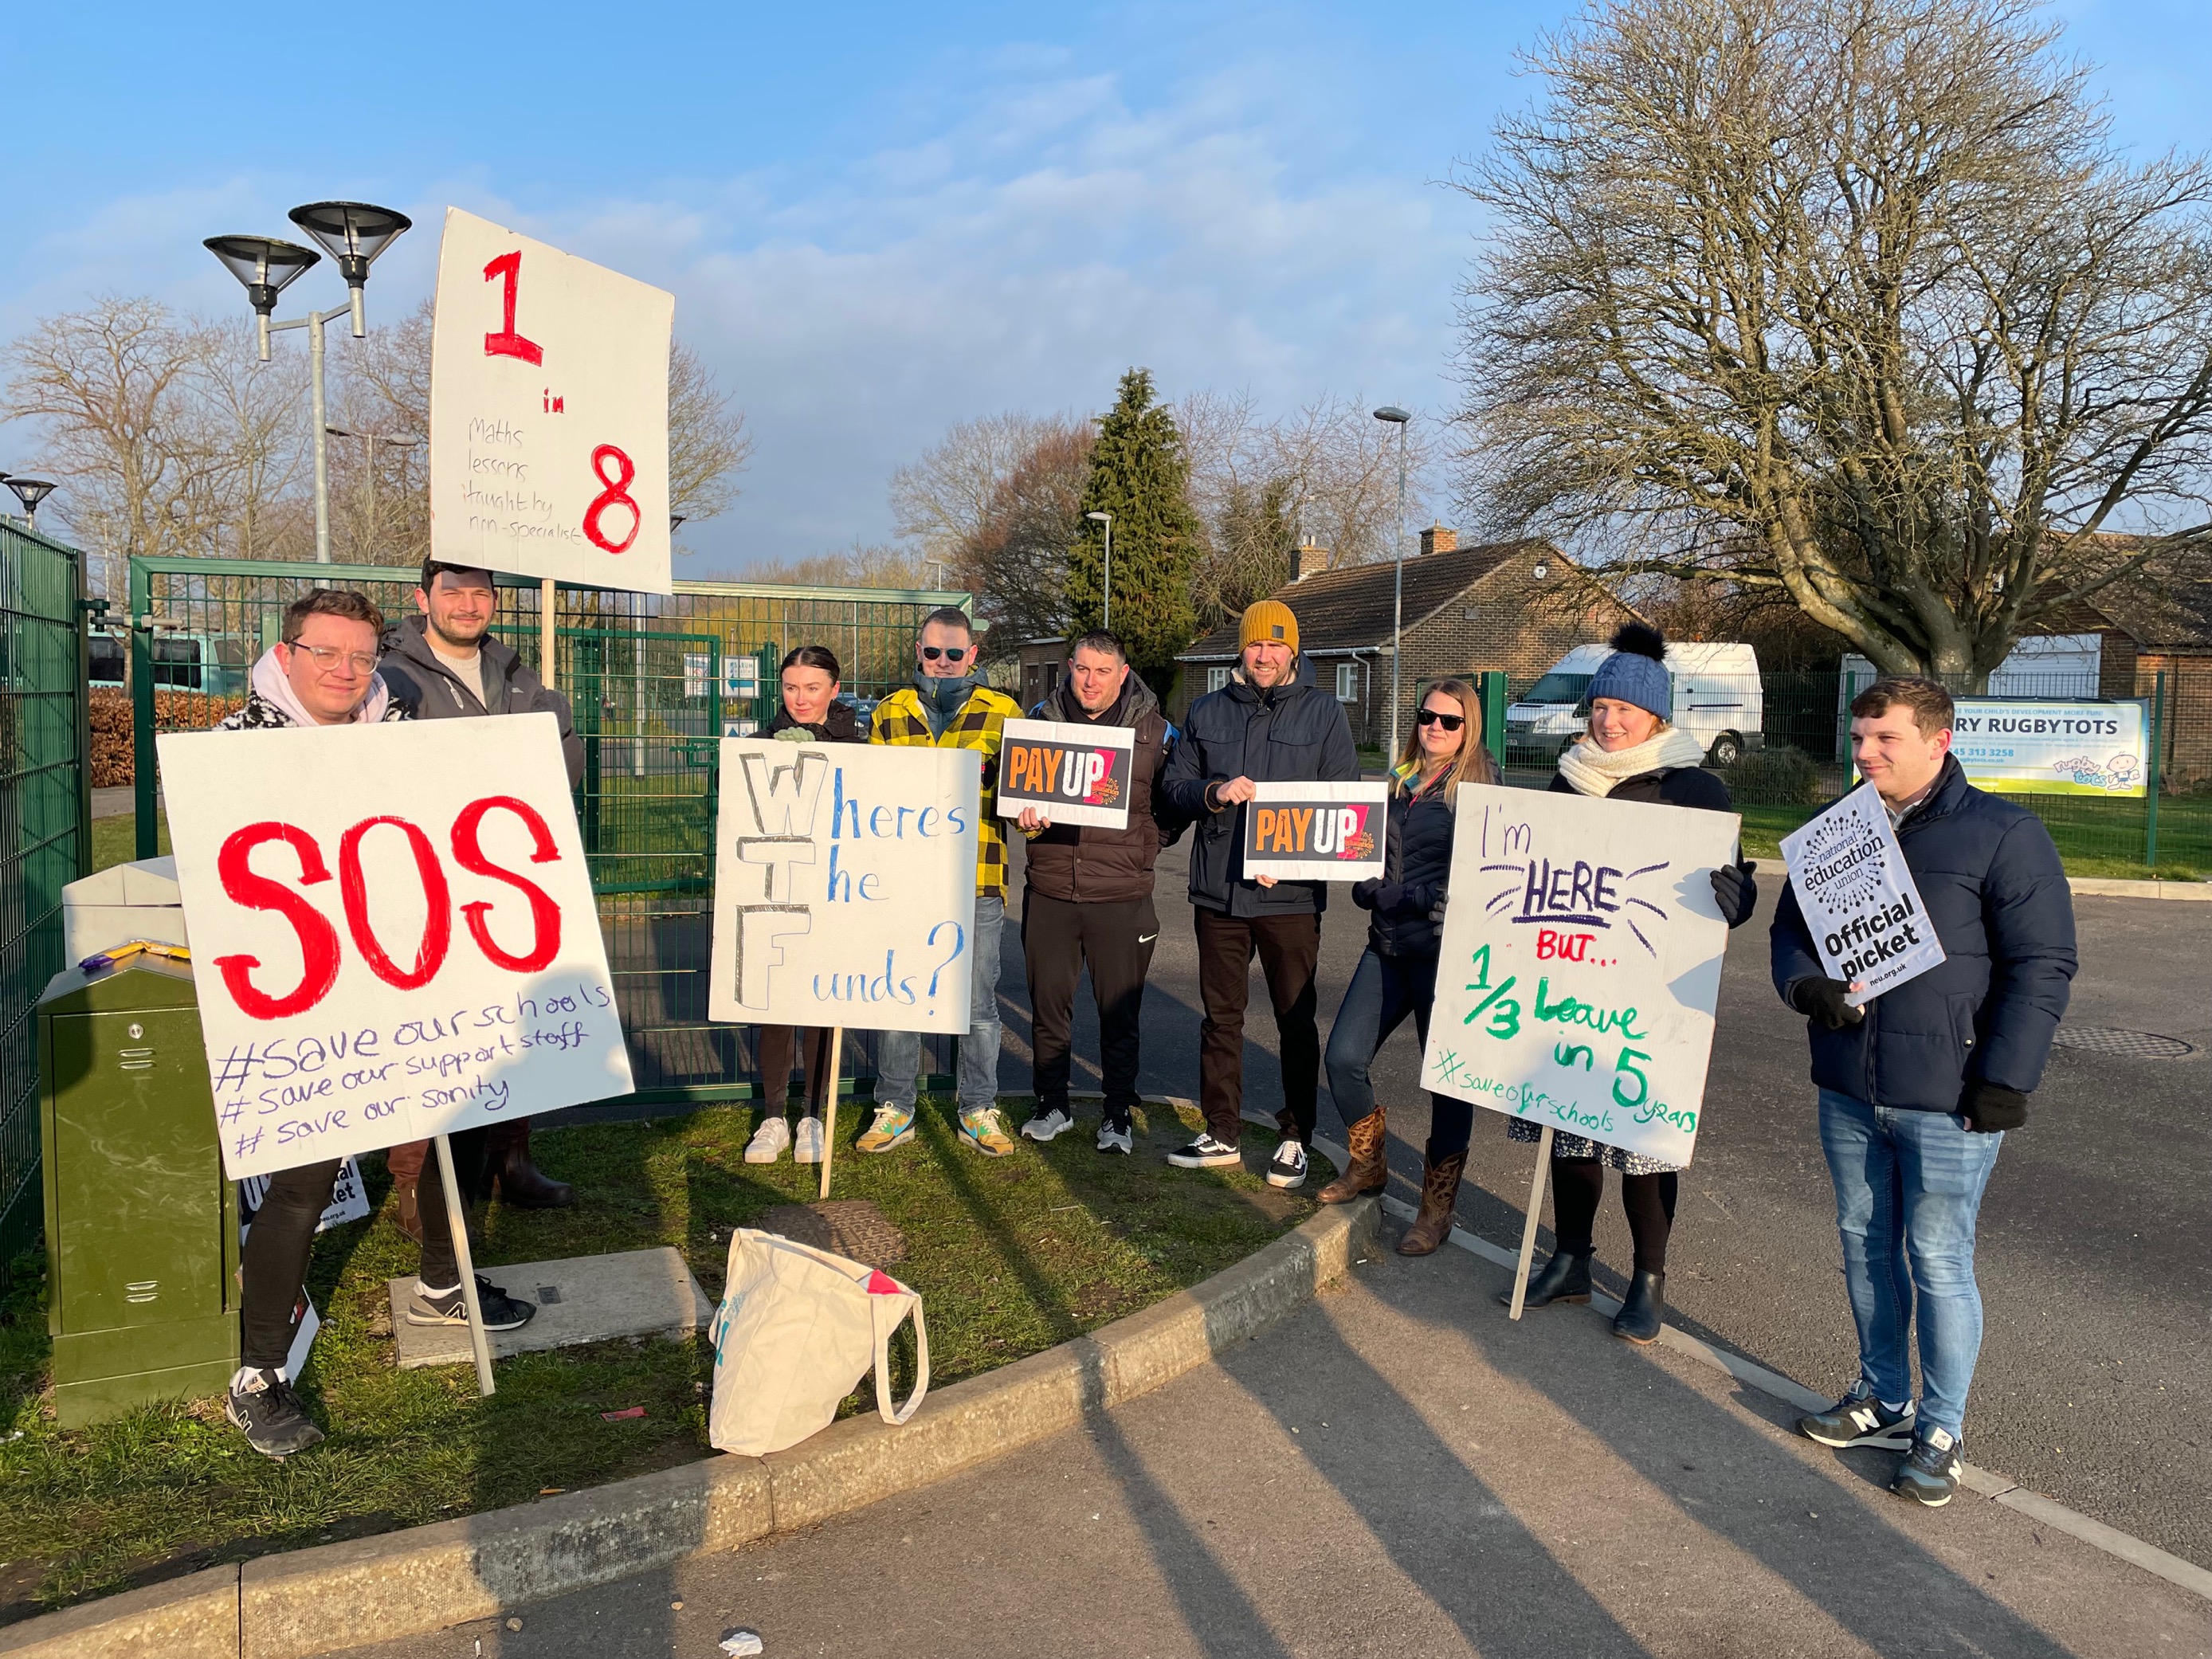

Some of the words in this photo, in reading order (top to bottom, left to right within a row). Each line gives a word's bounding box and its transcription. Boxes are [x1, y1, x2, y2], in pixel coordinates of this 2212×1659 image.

[483, 249, 544, 367] 1
[542, 386, 565, 414] in
[469, 417, 524, 448] Maths
[469, 448, 529, 483] lessons
[532, 491, 553, 522] by
[582, 443, 641, 554] 8
[1955, 717, 1983, 732] RY
[1988, 718, 2118, 735] RUGBYTOTS
[1008, 746, 1064, 793] PAY
[2053, 755, 2101, 775] rugby
[2073, 770, 2108, 787] tots
[1255, 808, 1314, 853] PAY
[1481, 803, 1532, 857] I'm
[1818, 831, 1858, 864] national
[1804, 835, 1886, 891] education
[1834, 867, 1865, 890] union
[212, 795, 563, 1021] SOS
[1522, 857, 1624, 916] HERE
[1824, 892, 1916, 957] Official
[1841, 923, 1920, 982] picket
[1869, 963, 1908, 987] neu.org.uk
[394, 1010, 468, 1045] our
[473, 983, 610, 1027] schools
[342, 1063, 399, 1089] our
[405, 1034, 516, 1077] support
[1554, 1030, 1594, 1073] in
[1612, 1045, 1653, 1108] 5
[364, 1096, 406, 1120] our
